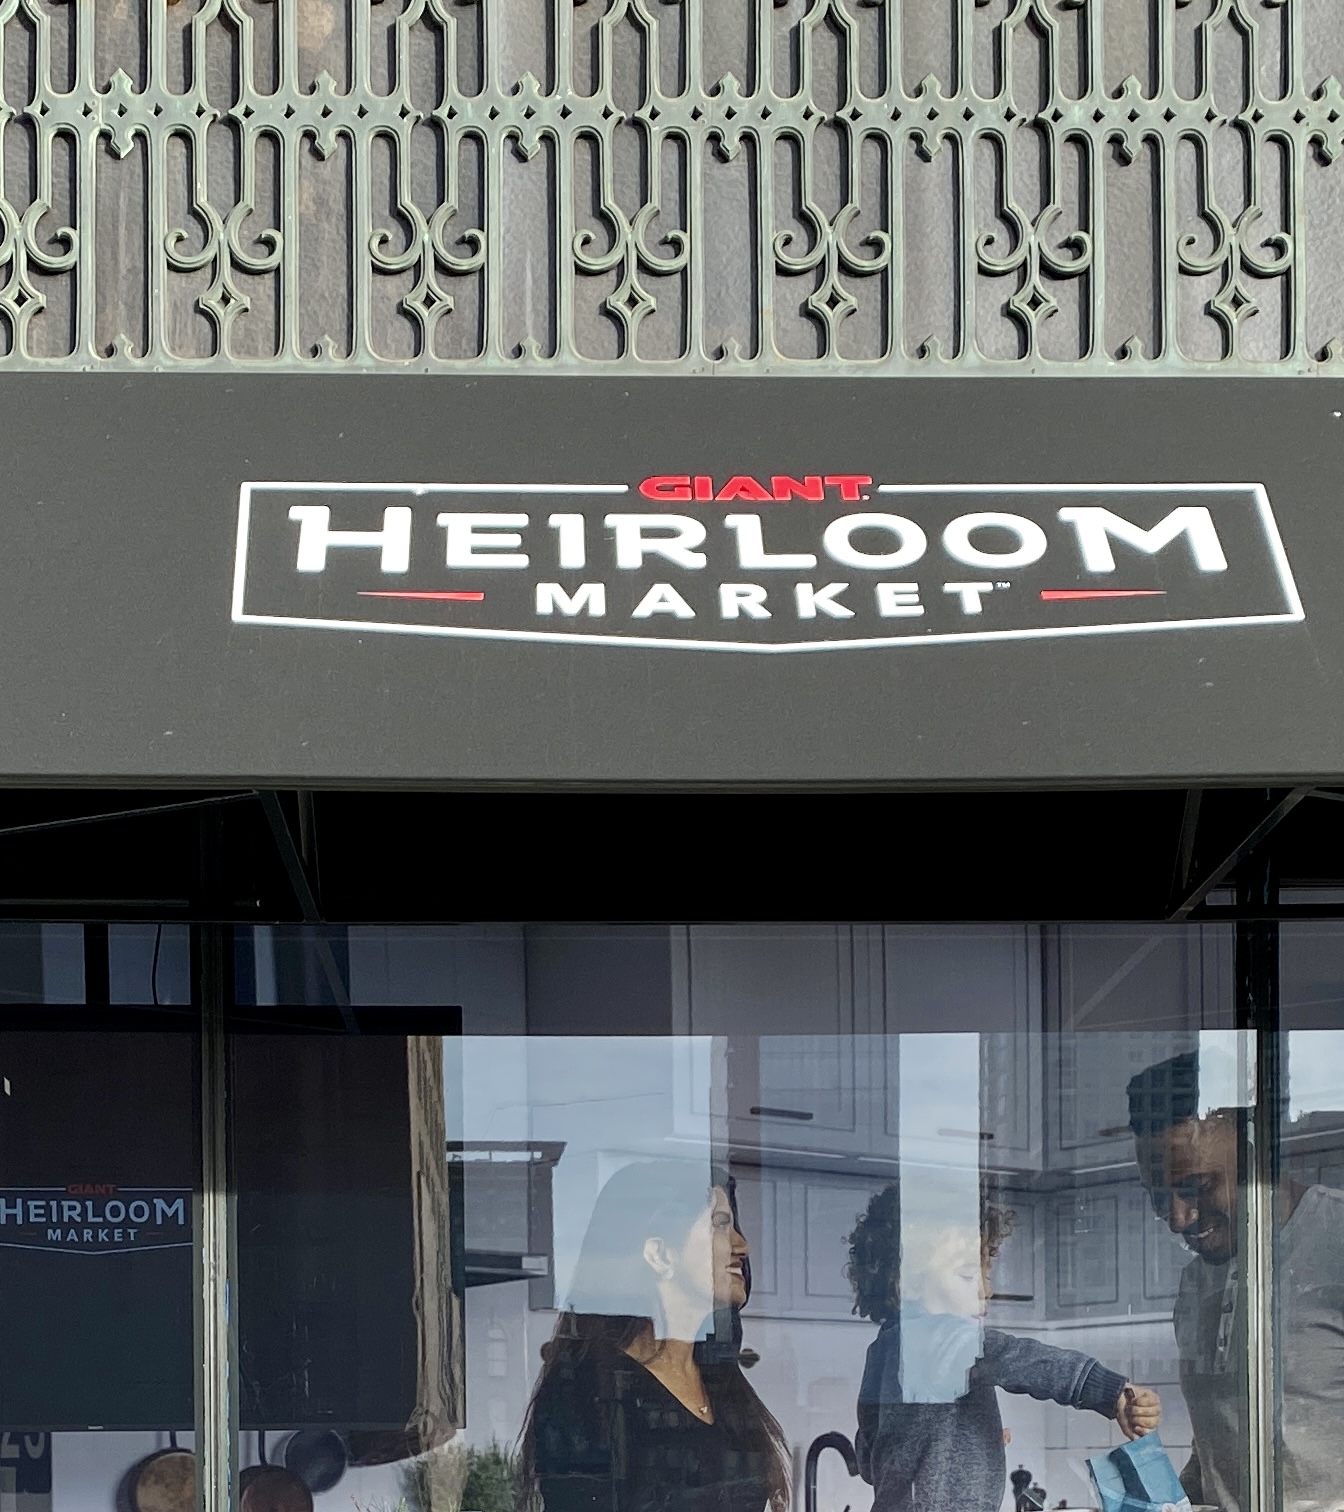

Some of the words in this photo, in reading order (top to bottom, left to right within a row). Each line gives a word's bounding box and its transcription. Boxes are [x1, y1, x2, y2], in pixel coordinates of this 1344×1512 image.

[638, 474, 873, 502] GIANT
[288, 503, 1229, 575] HEIRLOOM
[68, 1183, 116, 1195] GIANT
[46, 1228, 138, 1243] MARKET
